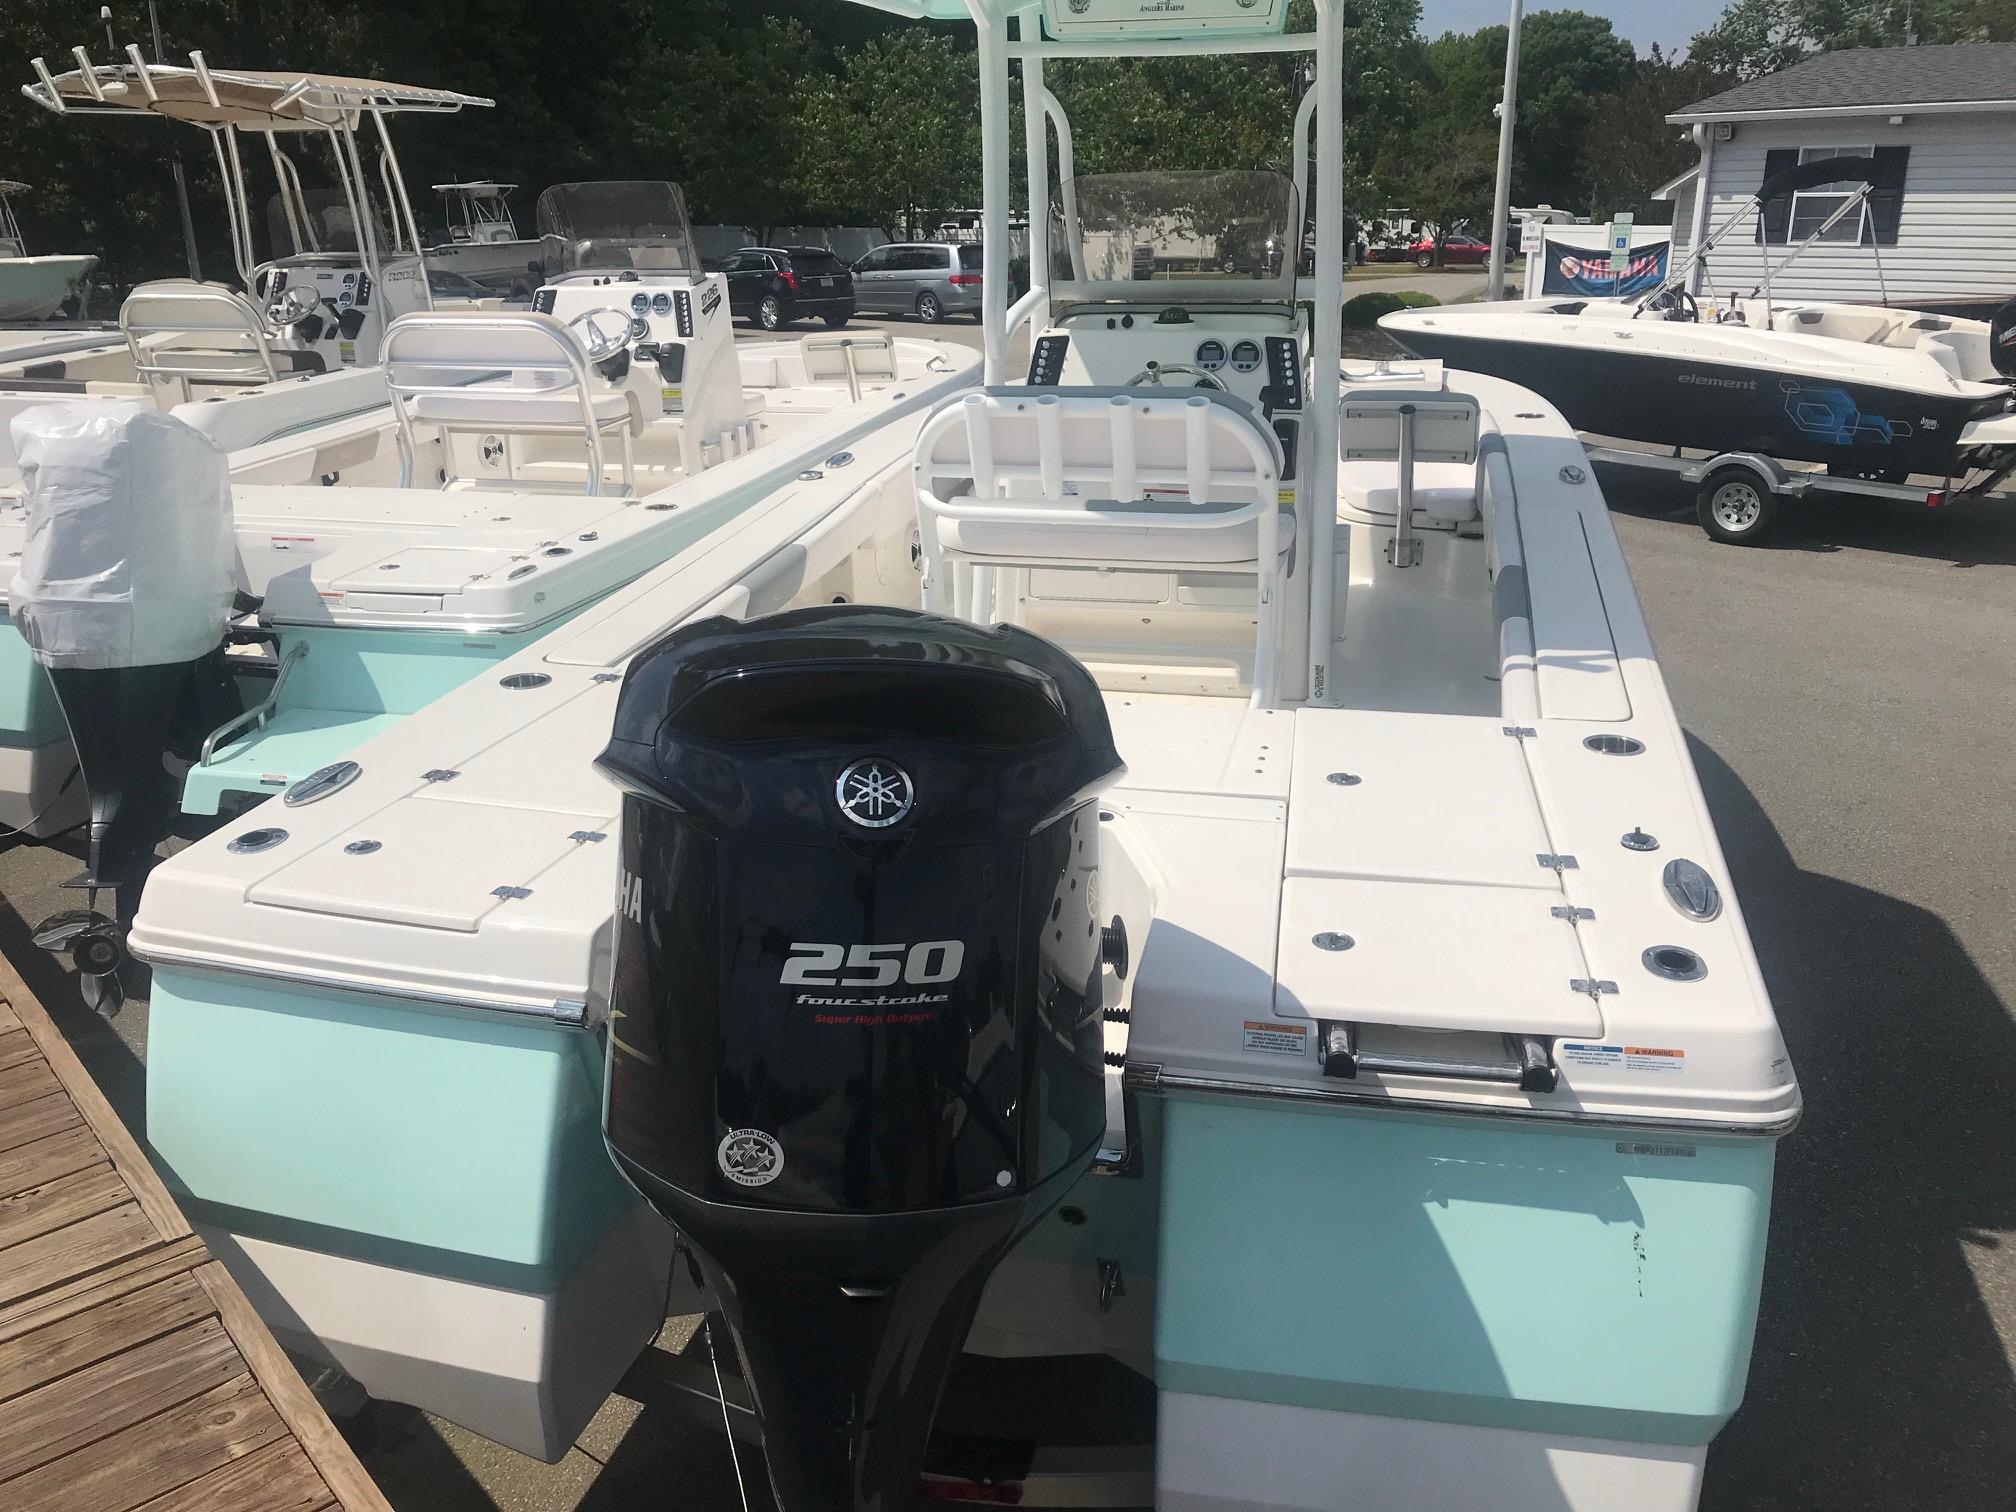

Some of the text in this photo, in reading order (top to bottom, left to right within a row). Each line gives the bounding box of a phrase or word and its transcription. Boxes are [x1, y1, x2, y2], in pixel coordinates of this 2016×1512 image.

[1678, 374, 1758, 390] element
[779, 939, 966, 987] 250
[796, 992, 950, 1006] fourstroke
[814, 1014, 852, 1025] Super
[854, 1014, 883, 1026] High
[1641, 1049, 1674, 1057] WARNING
